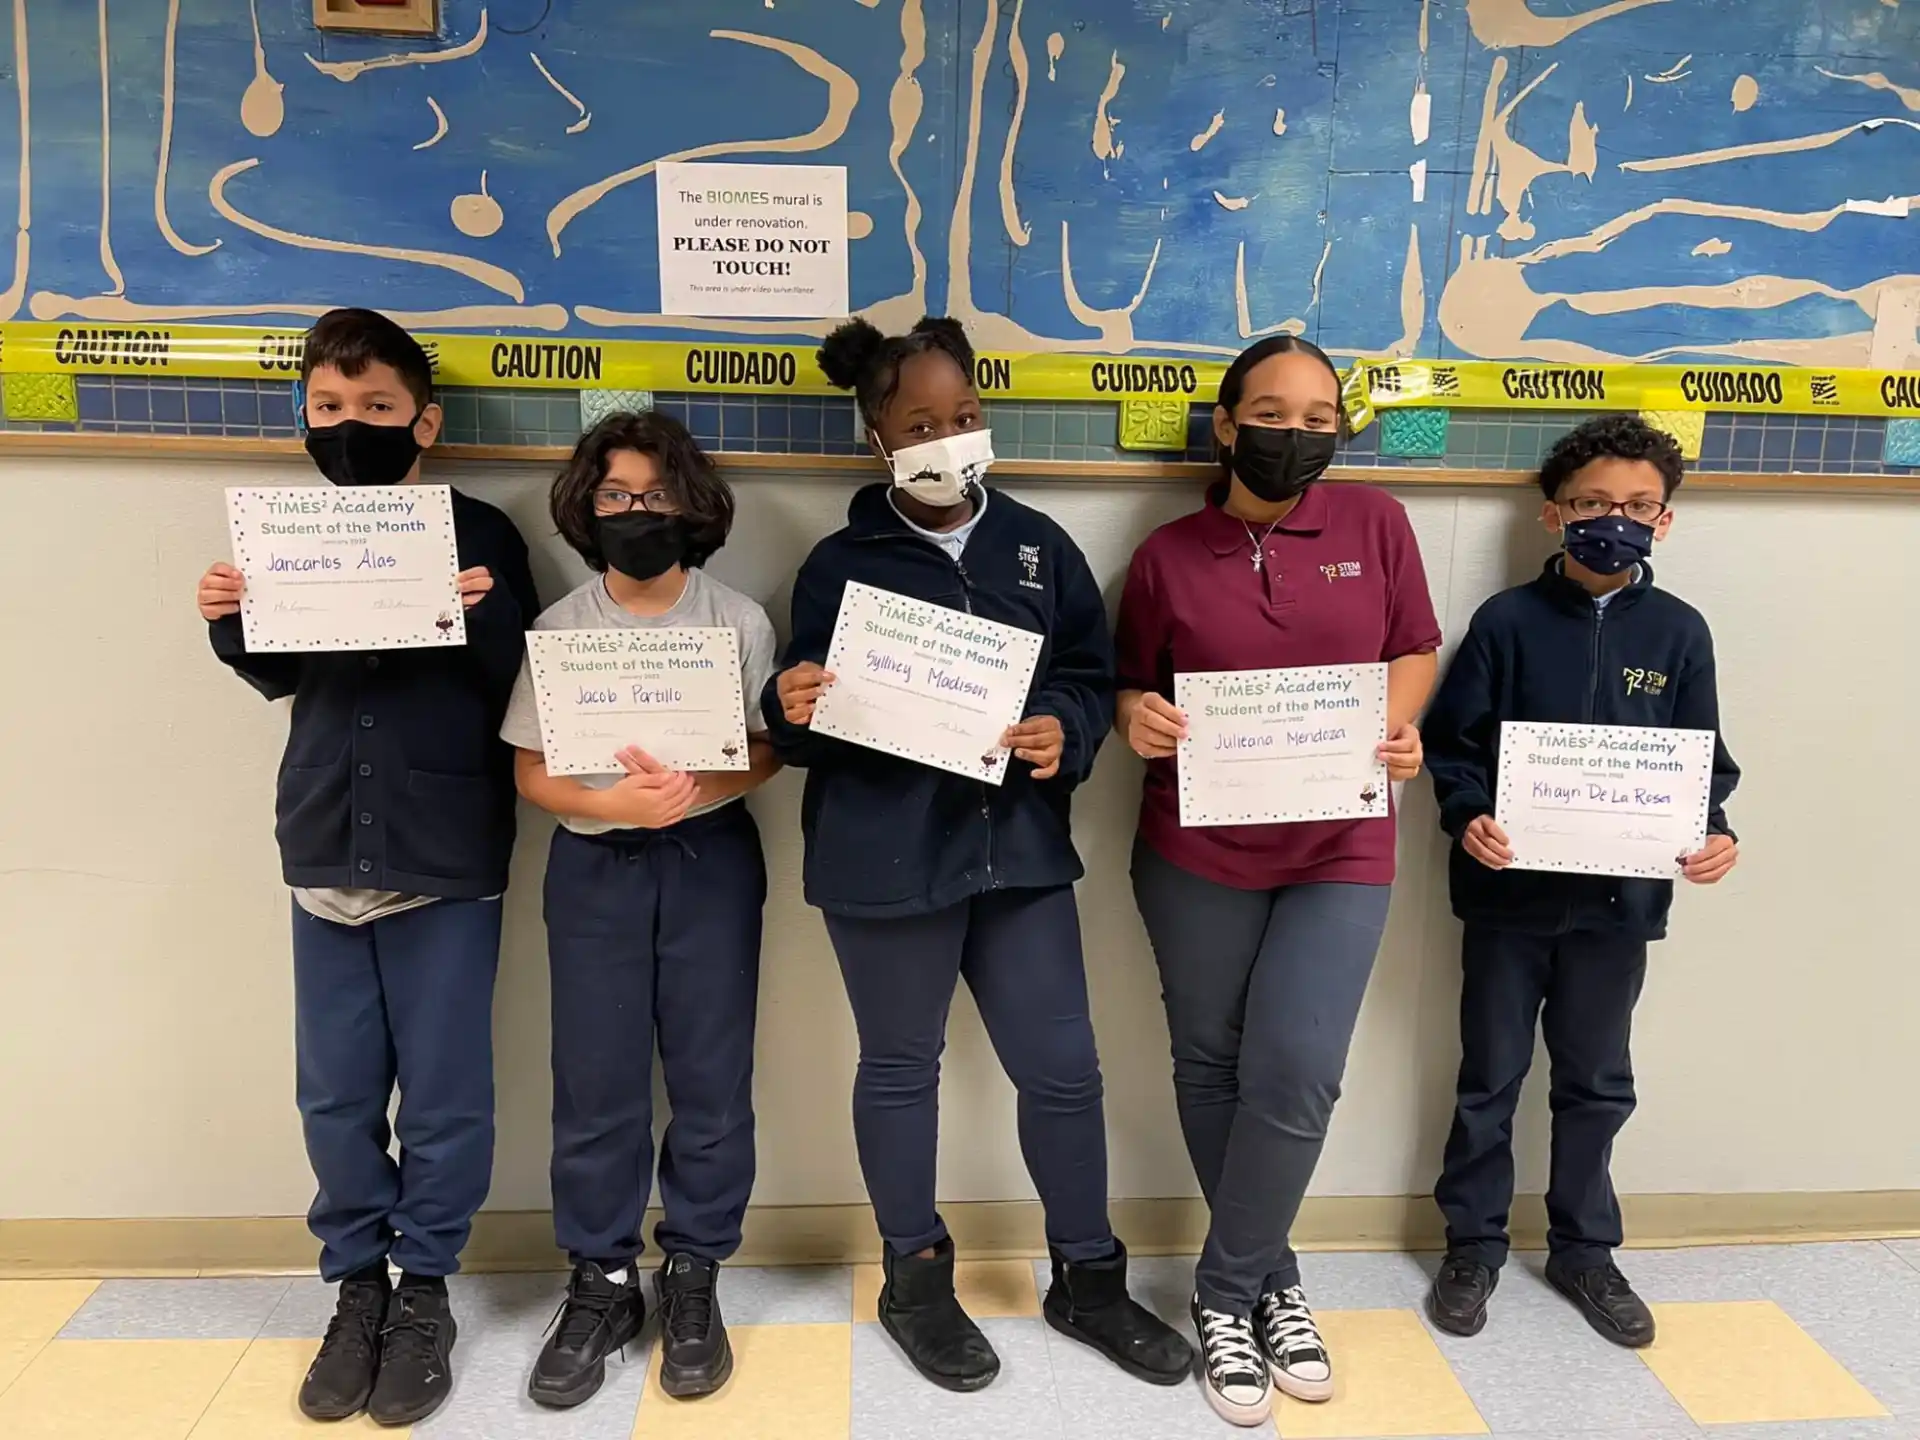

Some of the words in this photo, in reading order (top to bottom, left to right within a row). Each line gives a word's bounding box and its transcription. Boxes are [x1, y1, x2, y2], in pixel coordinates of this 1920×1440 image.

[678, 191, 702, 204] The
[707, 190, 769, 205] BIOMES
[772, 194, 809, 206] mural
[813, 194, 823, 206] is
[694, 215, 732, 228] under
[736, 216, 808, 230] renovation.
[673, 237, 750, 252] PLEASE
[755, 238, 784, 253] DO
[789, 239, 831, 254] NOT
[713, 260, 791, 276] TOUCH!
[689, 284, 704, 293] This
[705, 285, 721, 293] area
[55, 328, 171, 366] CAUTION
[491, 343, 602, 380] CAUTION
[685, 348, 796, 385] CUIDADO
[1091, 362, 1198, 395] CUIDADO
[1502, 367, 1606, 400] CAUTION
[1680, 370, 1784, 404] CUIDADO
[332, 501, 415, 516] Academy
[261, 522, 322, 535] Student
[326, 521, 342, 535] of
[346, 521, 372, 534] the
[376, 520, 426, 533] Month
[266, 552, 342, 572] Jancarlos
[356, 548, 396, 570] Alas
[1018, 551, 1039, 564] STEM
[1337, 561, 1361, 572] STEM
[864, 620, 918, 645] Student
[922, 638, 937, 651] of
[939, 640, 962, 657] the
[965, 649, 1009, 672] Month
[935, 621, 1007, 652] Academy
[628, 641, 704, 654] Academy
[560, 661, 618, 672] Student
[622, 660, 637, 671] of
[641, 659, 664, 670] the
[668, 658, 714, 669] Month
[927, 667, 989, 700] Madison
[1274, 679, 1352, 695] Academy
[575, 686, 617, 705] Jacob
[1204, 703, 1263, 717] Student
[1267, 702, 1281, 714] of
[1286, 699, 1310, 712] the
[1314, 696, 1360, 711] Month
[1286, 727, 1346, 746] Mendoza
[1597, 739, 1677, 756] Academy
[1527, 753, 1584, 767] Student
[1588, 756, 1603, 768] of
[1607, 757, 1631, 770] the
[1635, 759, 1684, 772] Month
[1532, 780, 1581, 804] Khayn
[1585, 782, 1608, 802] De
[1611, 788, 1629, 804] La
